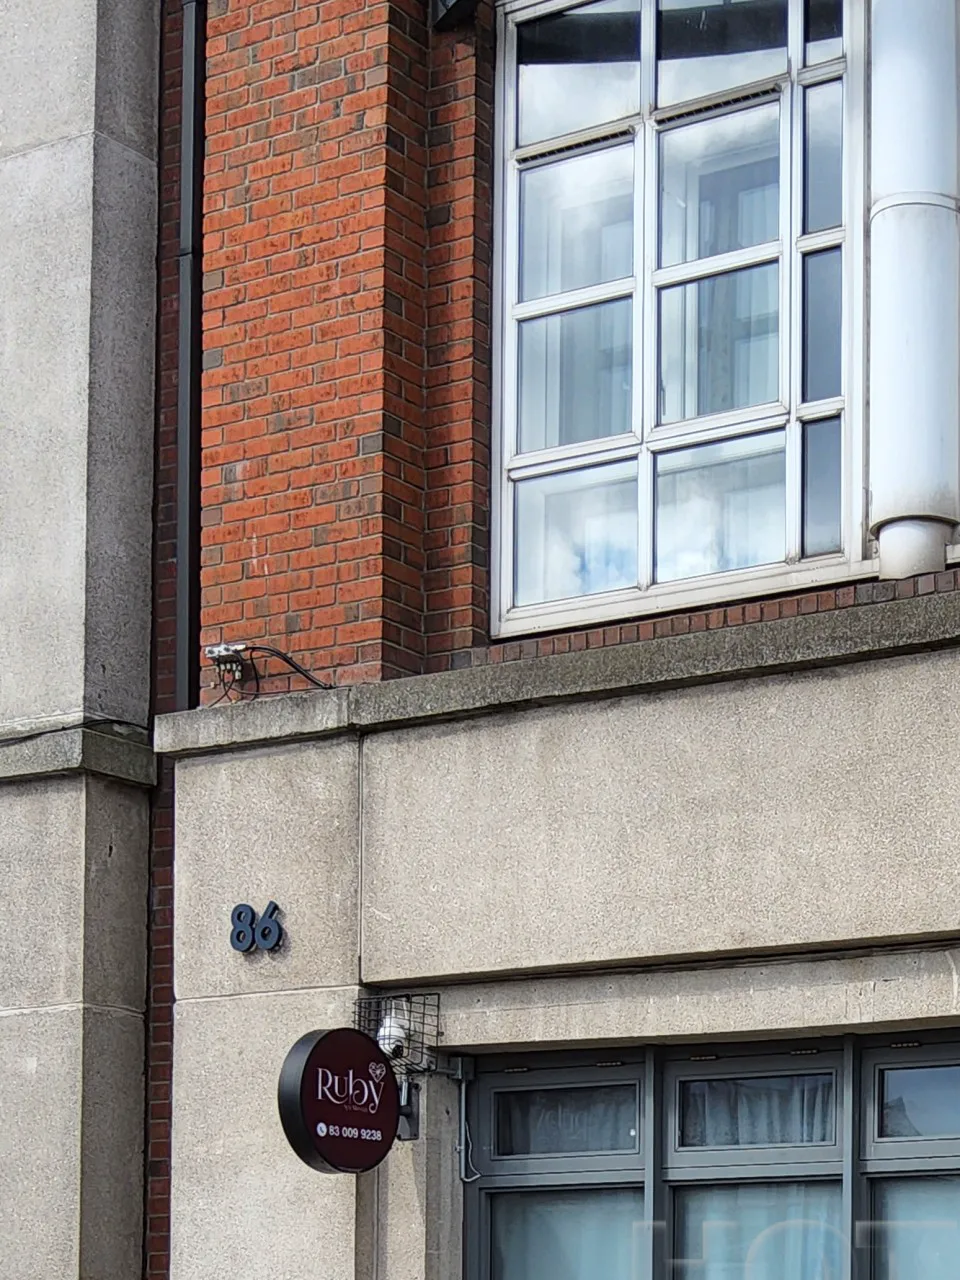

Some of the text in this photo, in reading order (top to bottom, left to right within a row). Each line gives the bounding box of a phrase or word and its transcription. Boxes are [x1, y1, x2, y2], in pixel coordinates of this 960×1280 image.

[230, 900, 283, 952] 86
[317, 1067, 385, 1114] Ruby
[328, 1125, 382, 1141] 83 009 9238
